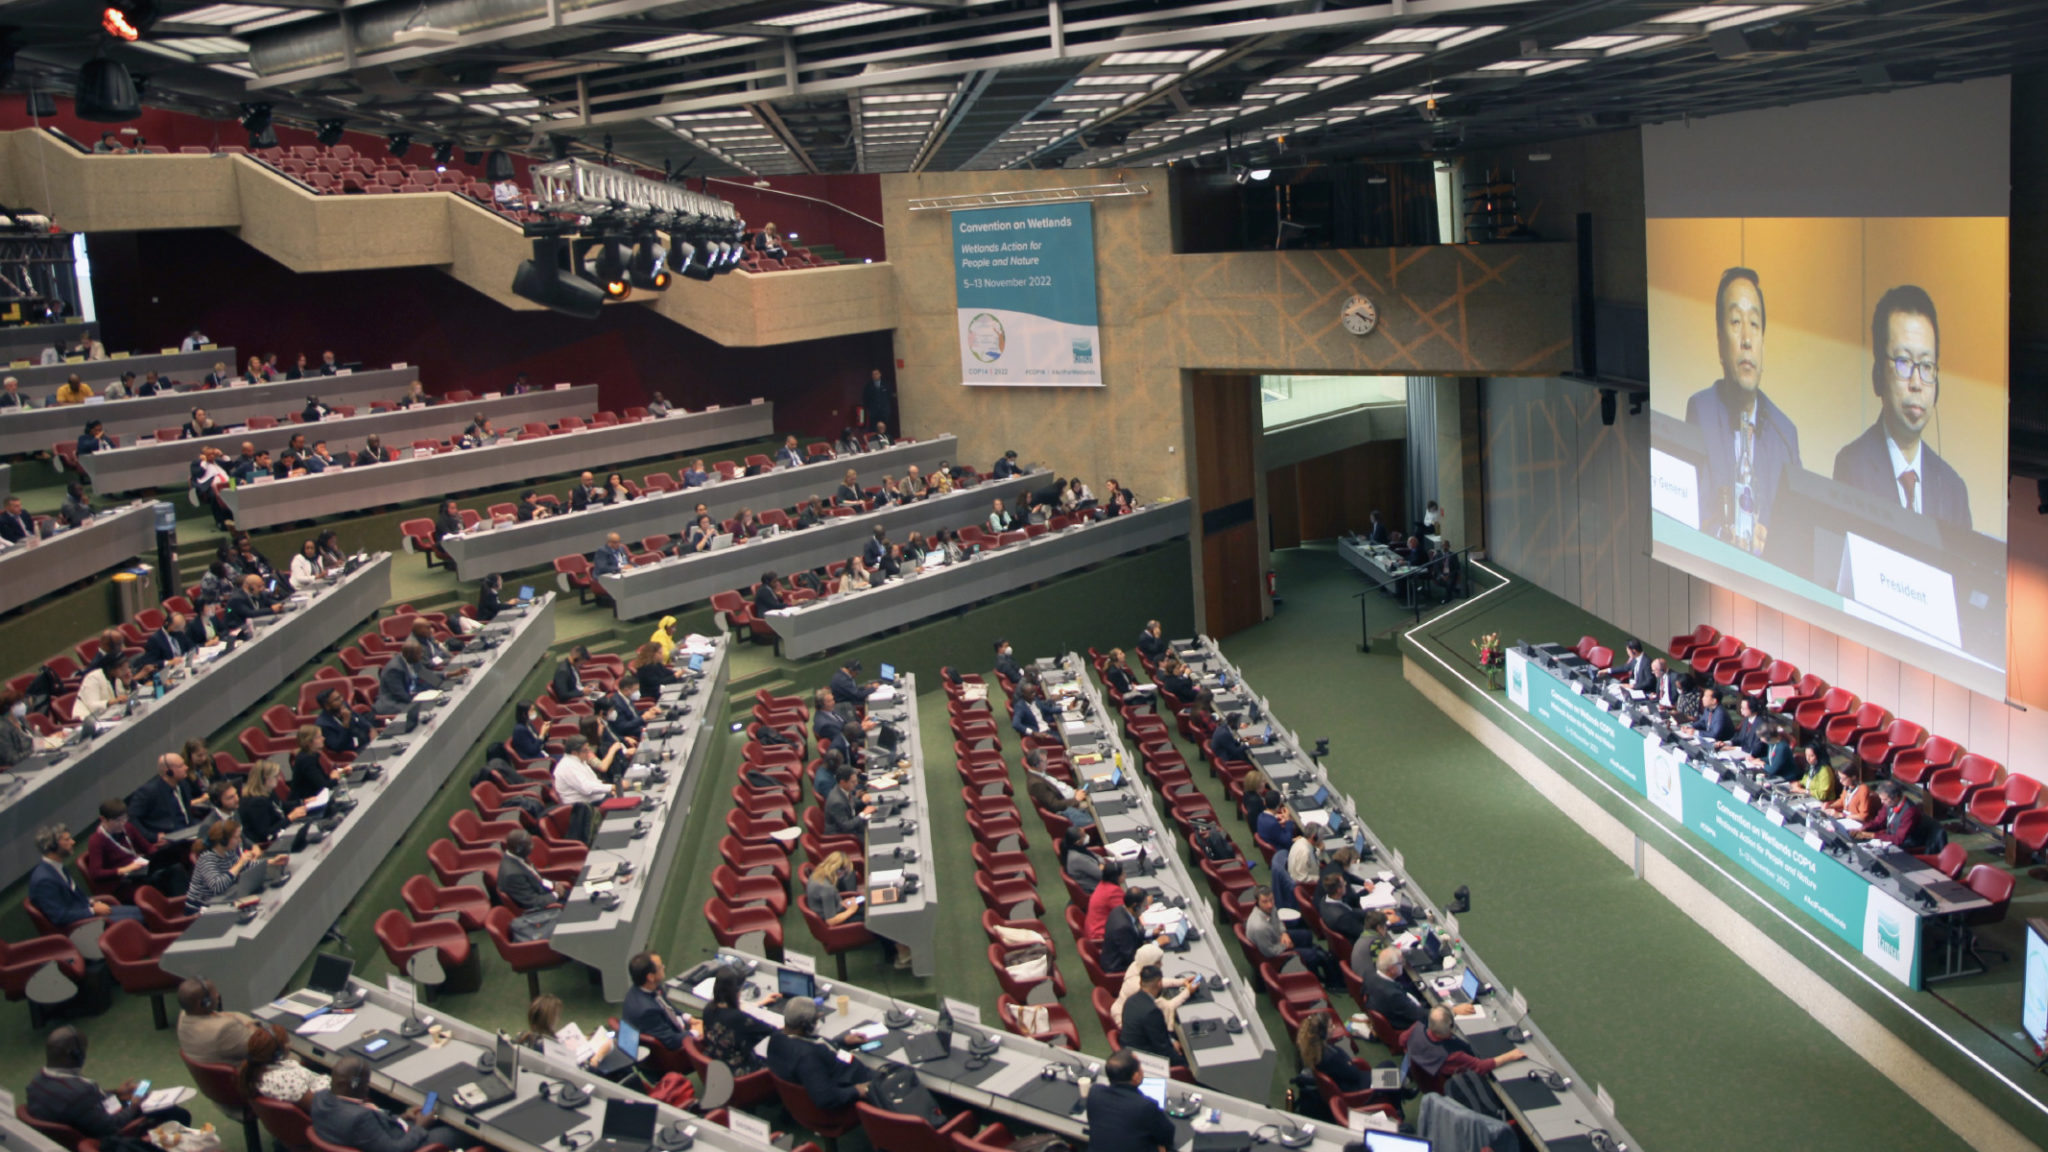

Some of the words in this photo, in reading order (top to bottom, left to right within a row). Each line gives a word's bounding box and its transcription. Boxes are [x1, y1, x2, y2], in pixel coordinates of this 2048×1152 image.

[960, 221, 1012, 233] Convention
[1013, 221, 1026, 230] on
[1027, 216, 1072, 229] Wetlands
[961, 243, 999, 254] Wetlands
[1000, 242, 1028, 252] Action
[1029, 241, 1042, 250] for
[962, 258, 990, 269] People
[992, 257, 1009, 267] and
[1010, 256, 1039, 266] Nature
[984, 277, 1026, 288] November
[1028, 275, 1052, 287] 2022
[1659, 476, 1689, 499] General
[1879, 572, 1928, 606] President
[1717, 800, 1751, 829] Convention
[1752, 825, 1760, 836] on
[1761, 827, 1792, 858] Wetlands
[1793, 850, 1816, 874] COP14
[1716, 815, 1739, 838] Wetlands
[1739, 832, 1756, 848] Action
[1756, 842, 1764, 854] for
[1765, 848, 1784, 868] People
[1784, 862, 1797, 877] and
[1797, 871, 1817, 890] Nature
